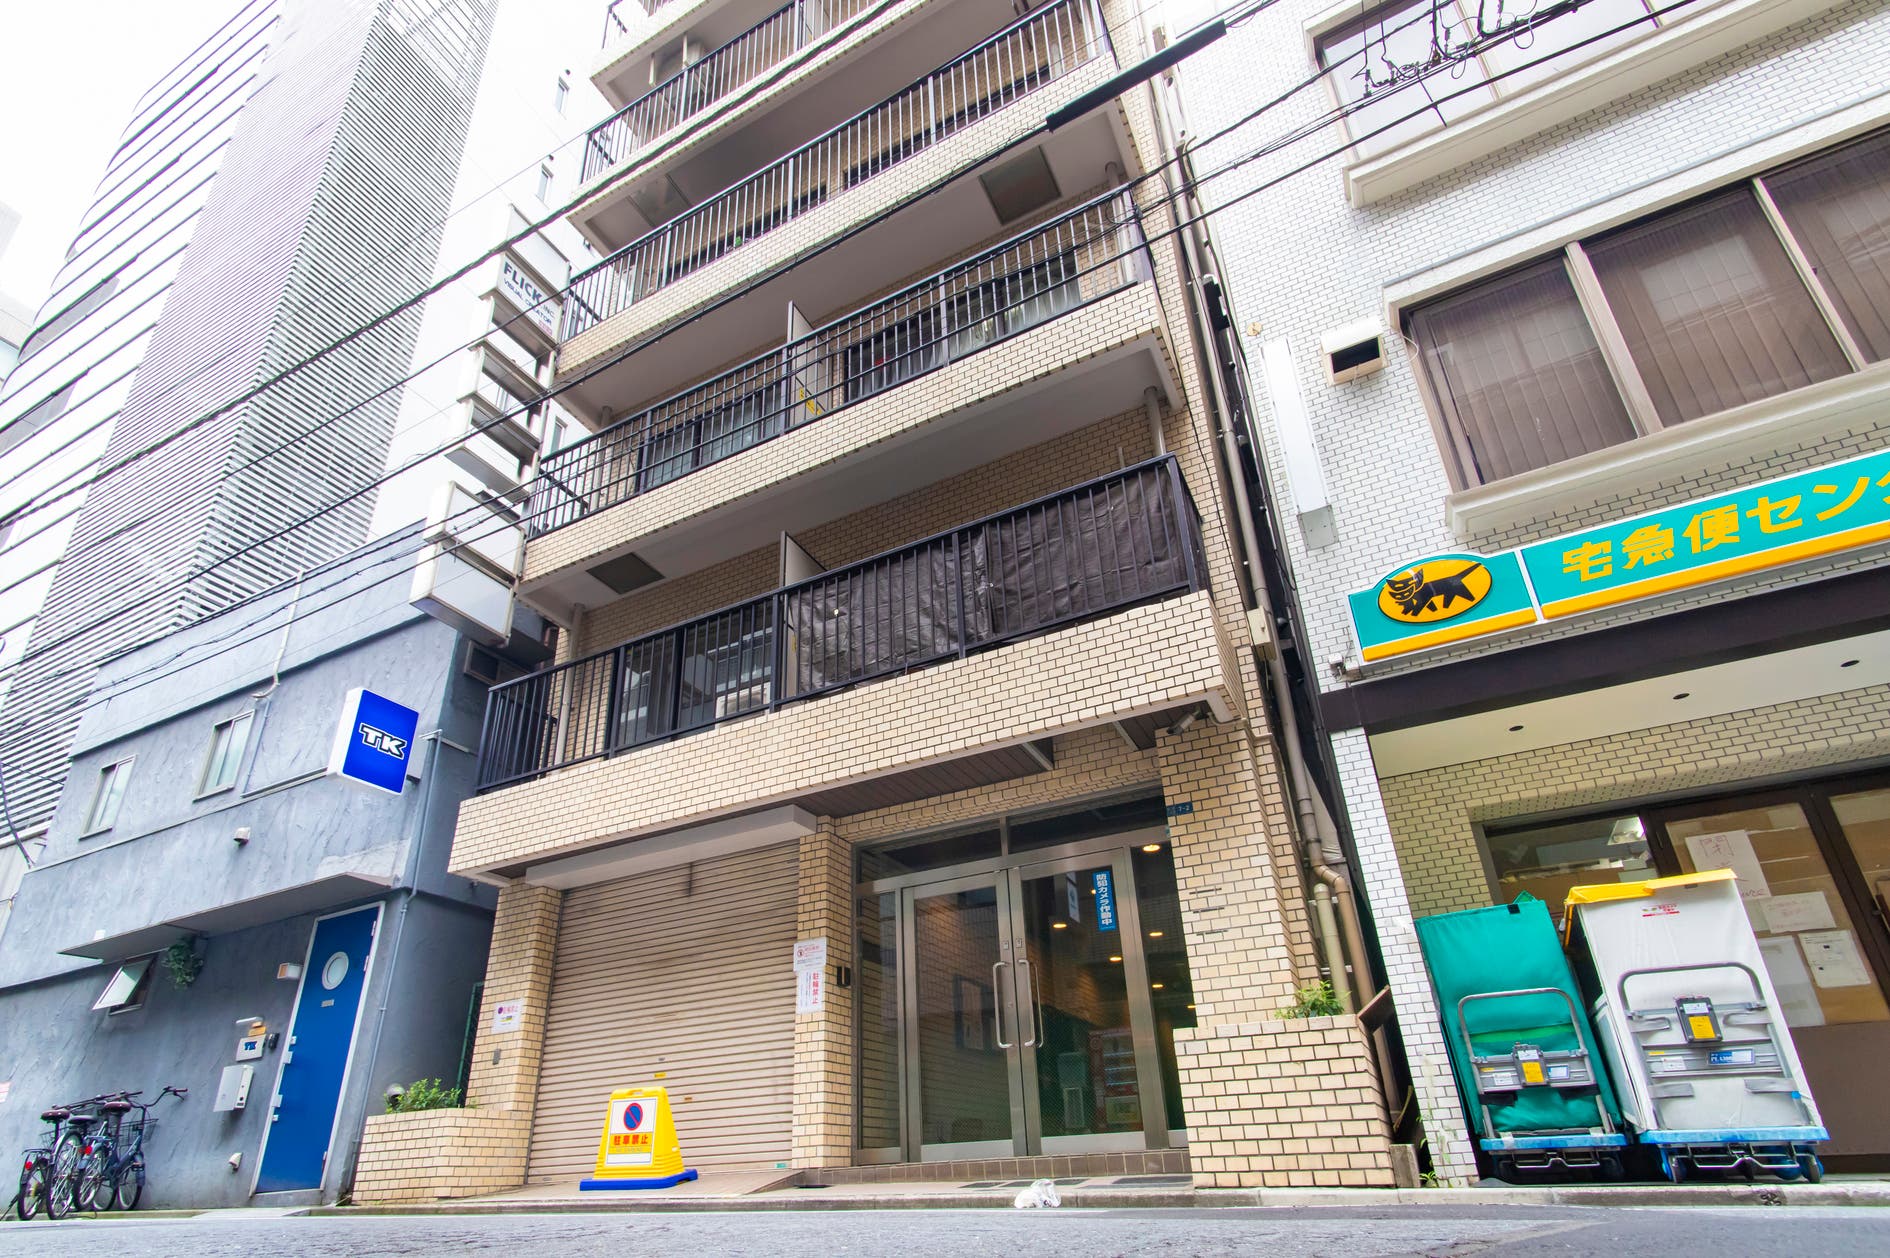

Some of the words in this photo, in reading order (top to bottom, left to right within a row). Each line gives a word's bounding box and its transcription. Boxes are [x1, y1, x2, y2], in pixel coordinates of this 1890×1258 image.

[503, 261, 542, 304] FLICK
[359, 723, 408, 760] TK
[1096, 873, 1113, 926] 防犯カメラ作動中
[244, 1041, 257, 1051] TK
[613, 1134, 649, 1146] 駐車禁止
